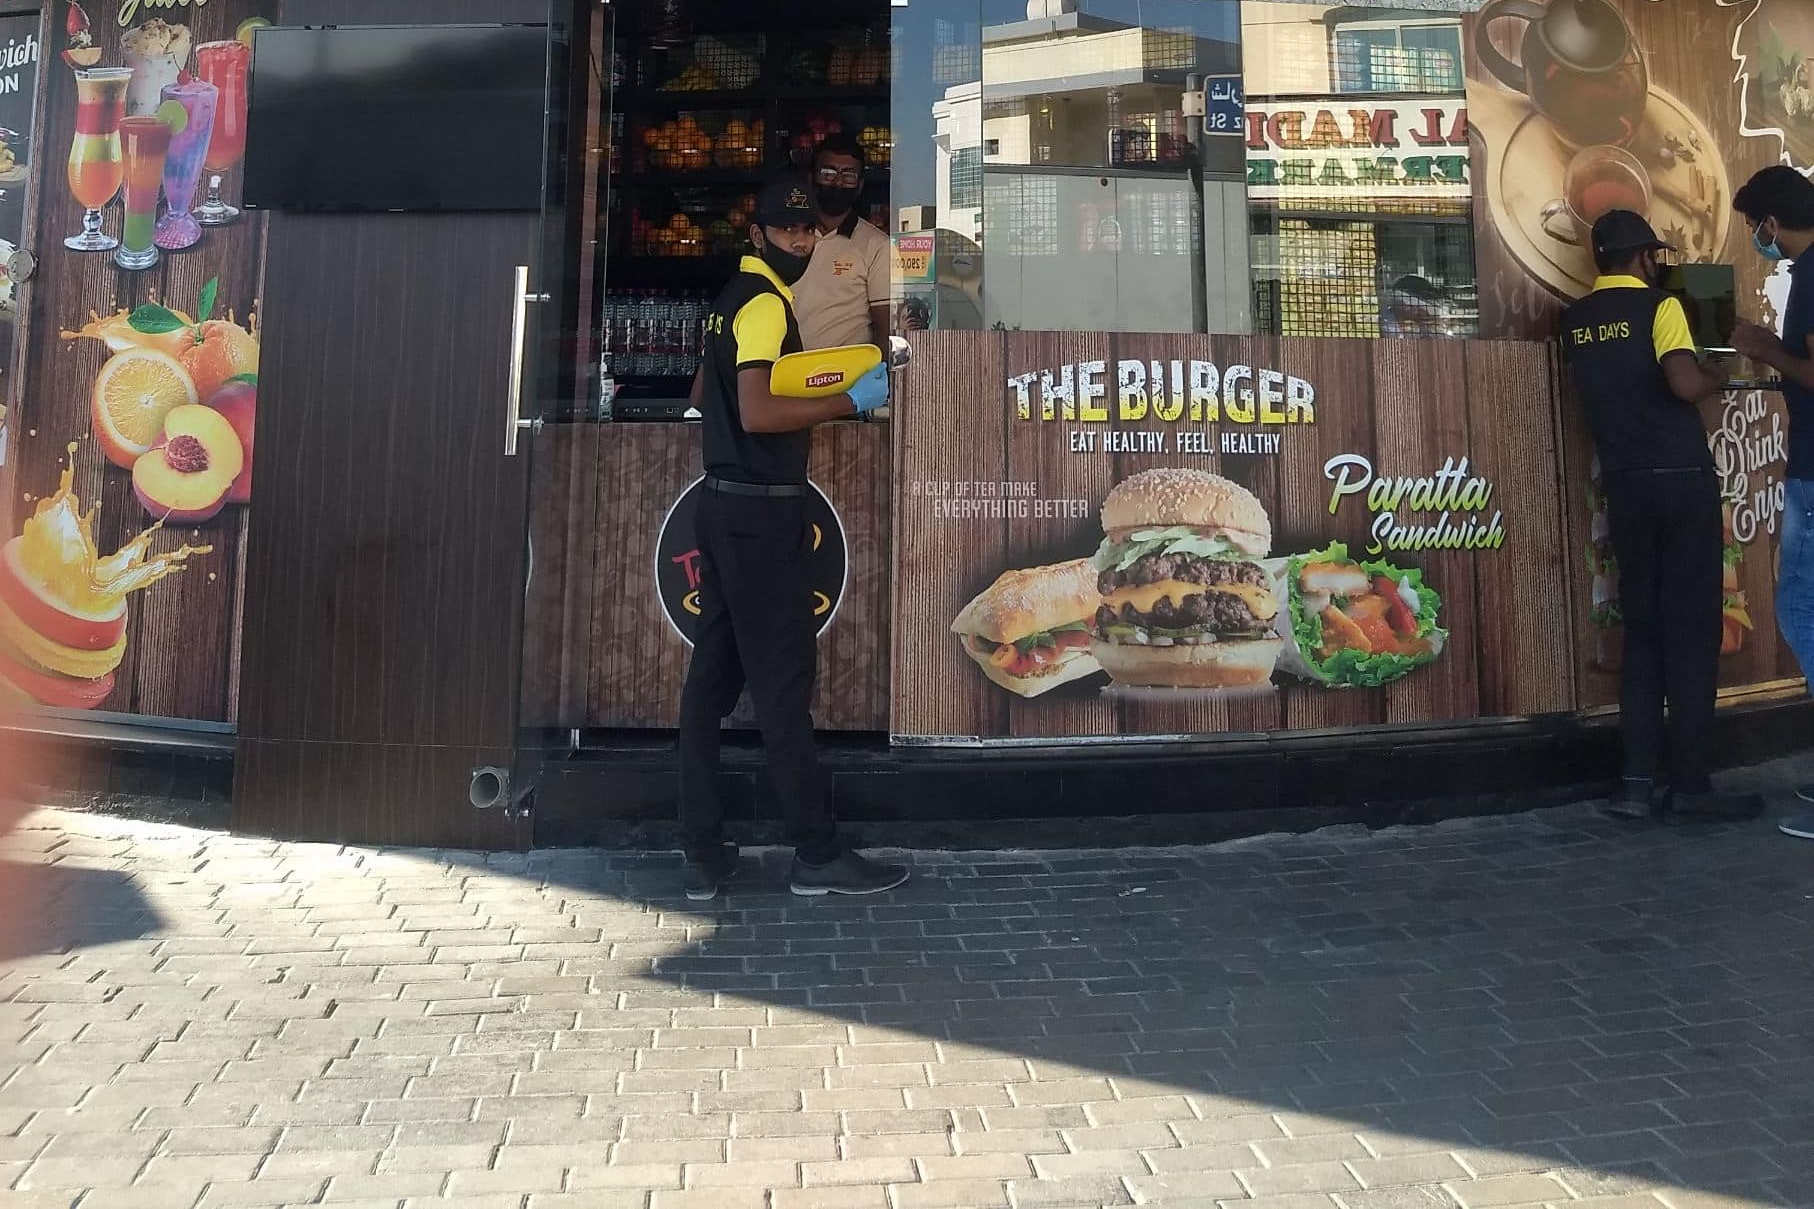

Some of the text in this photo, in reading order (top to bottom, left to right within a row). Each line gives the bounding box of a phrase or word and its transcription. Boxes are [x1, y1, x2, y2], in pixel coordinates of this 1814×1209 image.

[1571, 321, 1631, 346] TEA DAYS
[808, 373, 842, 387] Lipton
[1007, 358, 1316, 424] THE BURGER
[1070, 431, 1281, 455] EAT HEALTHY, FEEL, HEALTHY
[925, 480, 950, 497] CUP
[955, 480, 970, 497] OF
[973, 481, 996, 497] TEA
[1000, 481, 1038, 497] MAKE
[1323, 453, 1493, 515] Paratta
[934, 499, 1089, 519] EVERYTHING BETTER
[1732, 473, 1785, 542] Enjo
[1365, 509, 1506, 555] Sandwich
